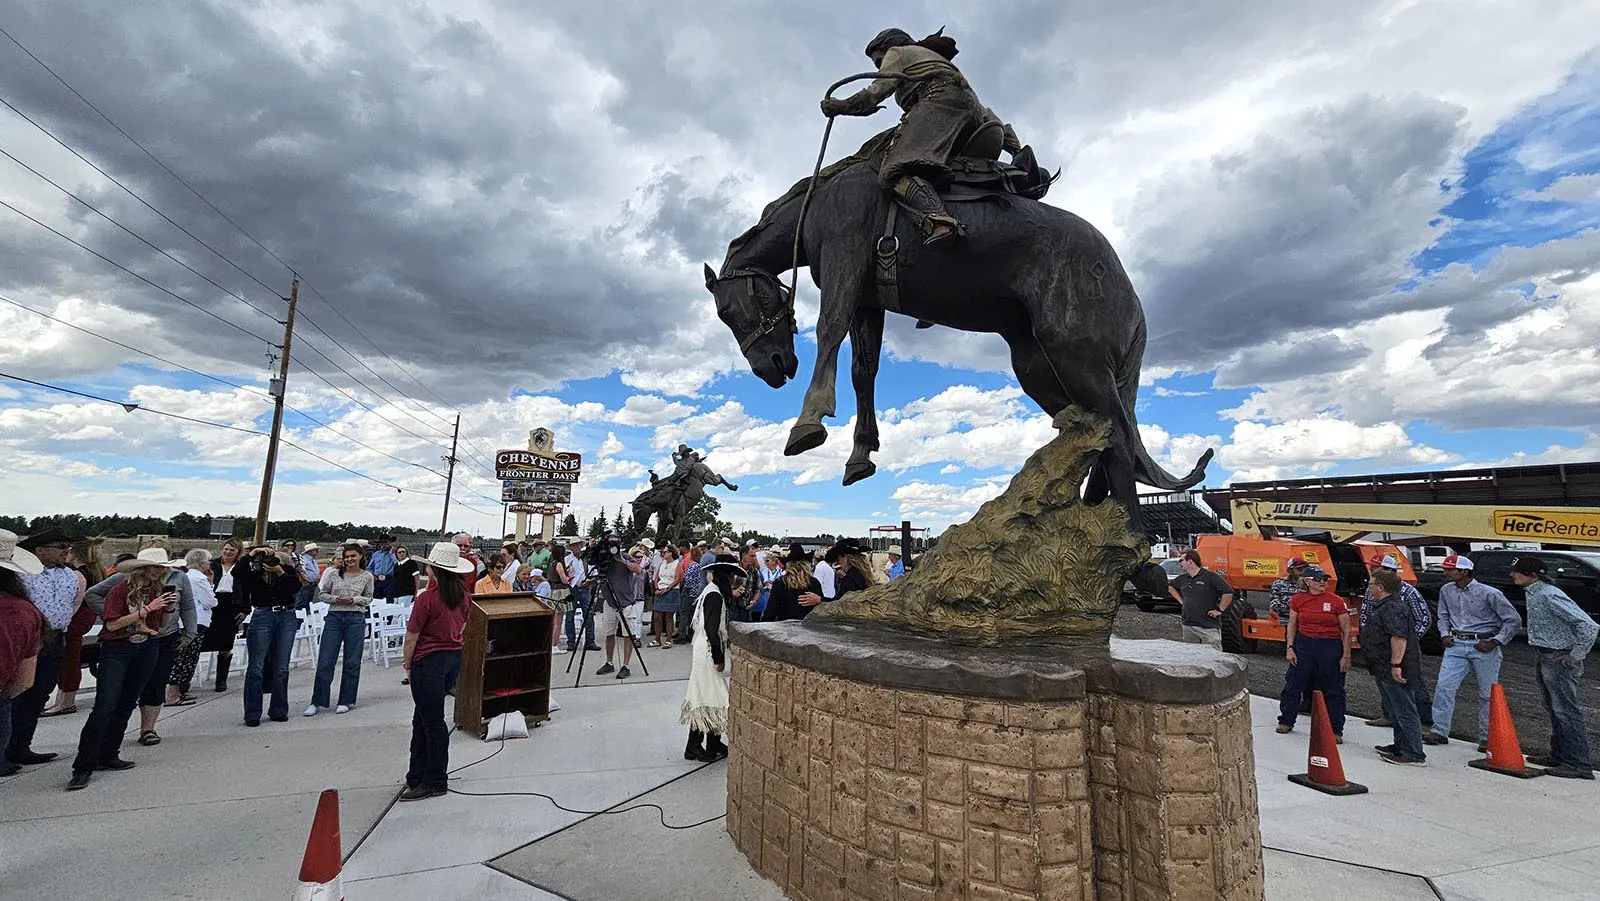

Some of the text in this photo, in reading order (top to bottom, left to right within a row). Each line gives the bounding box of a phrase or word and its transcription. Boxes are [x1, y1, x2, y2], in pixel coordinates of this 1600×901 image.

[498, 453, 578, 470] CHEYENNE
[500, 470, 576, 480] FRONTIER DAYS
[1272, 504, 1318, 515] JLG LIFT
[1502, 519, 1600, 536] HercRenta
[1245, 563, 1277, 571] HercRentals
